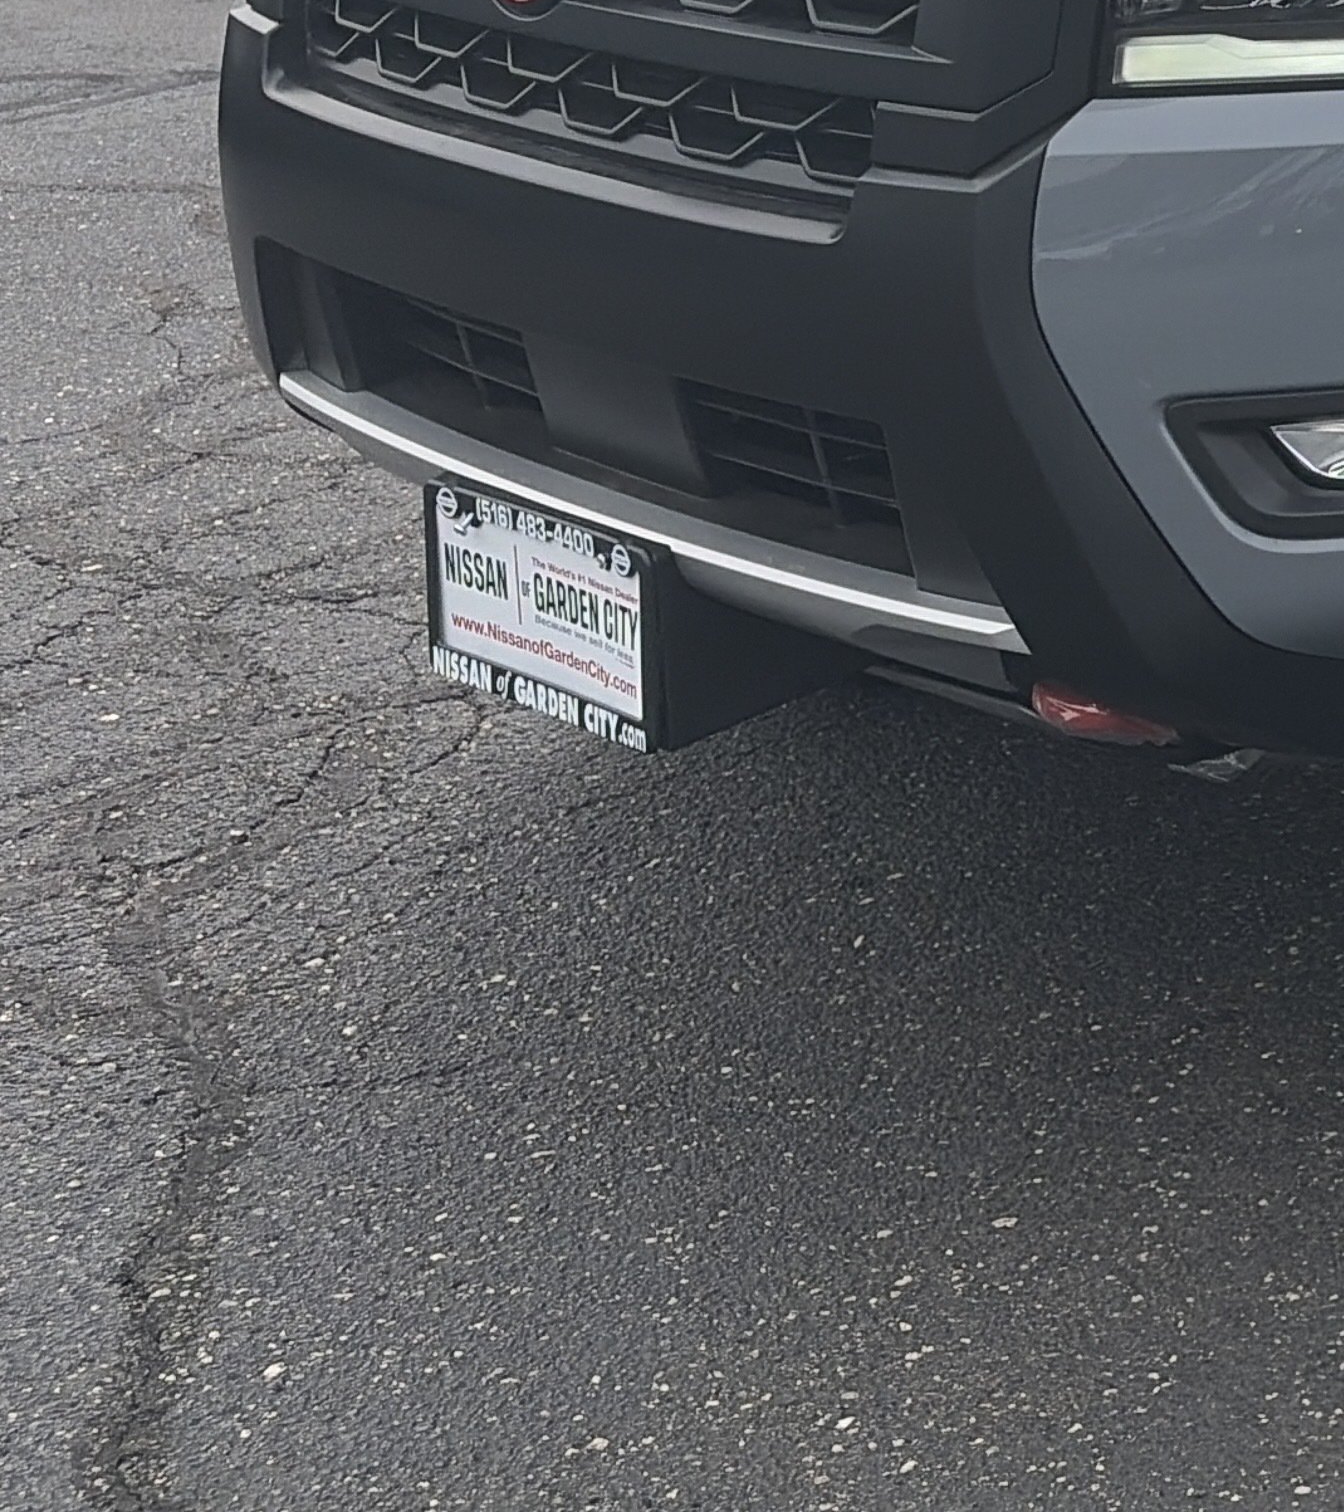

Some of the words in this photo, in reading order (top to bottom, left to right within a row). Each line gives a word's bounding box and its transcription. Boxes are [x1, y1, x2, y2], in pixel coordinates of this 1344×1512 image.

[475, 497, 513, 531] (516)
[516, 512, 595, 558] 483-4400
[444, 542, 509, 601] NISSAN
[533, 573, 600, 635] GARDEN
[603, 598, 638, 652] CITY
[432, 645, 493, 694] NISSAN
[496, 670, 511, 700] of
[514, 679, 580, 727] GARDEN
[583, 702, 648, 754] CITY.com
[451, 611, 638, 700] www.NissanofGardenCity.com
